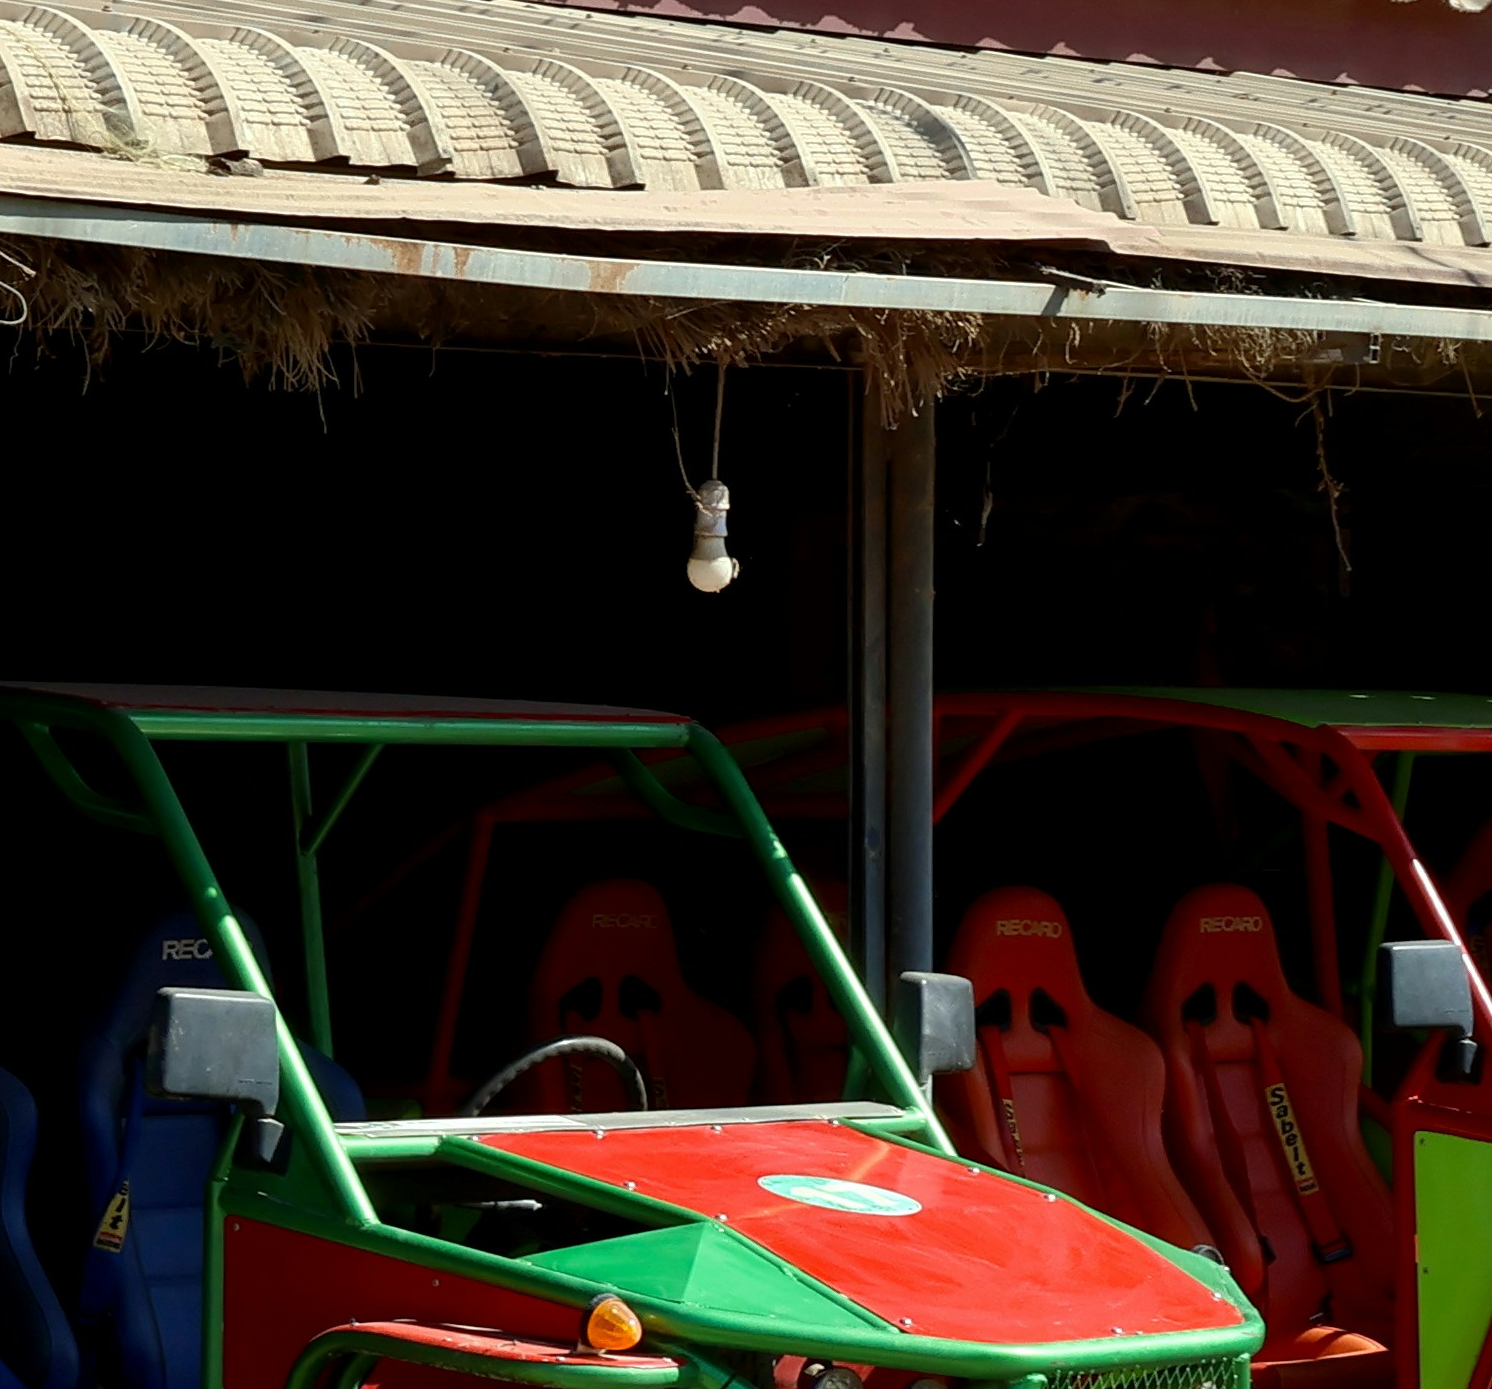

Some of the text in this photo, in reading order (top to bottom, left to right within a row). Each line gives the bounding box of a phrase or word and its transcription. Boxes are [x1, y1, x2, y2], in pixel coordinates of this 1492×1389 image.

[996, 919, 1063, 938] RECARO
[1199, 916, 1264, 933] RECARO
[161, 938, 214, 961] REC
[1269, 1086, 1307, 1176] Sabelt
